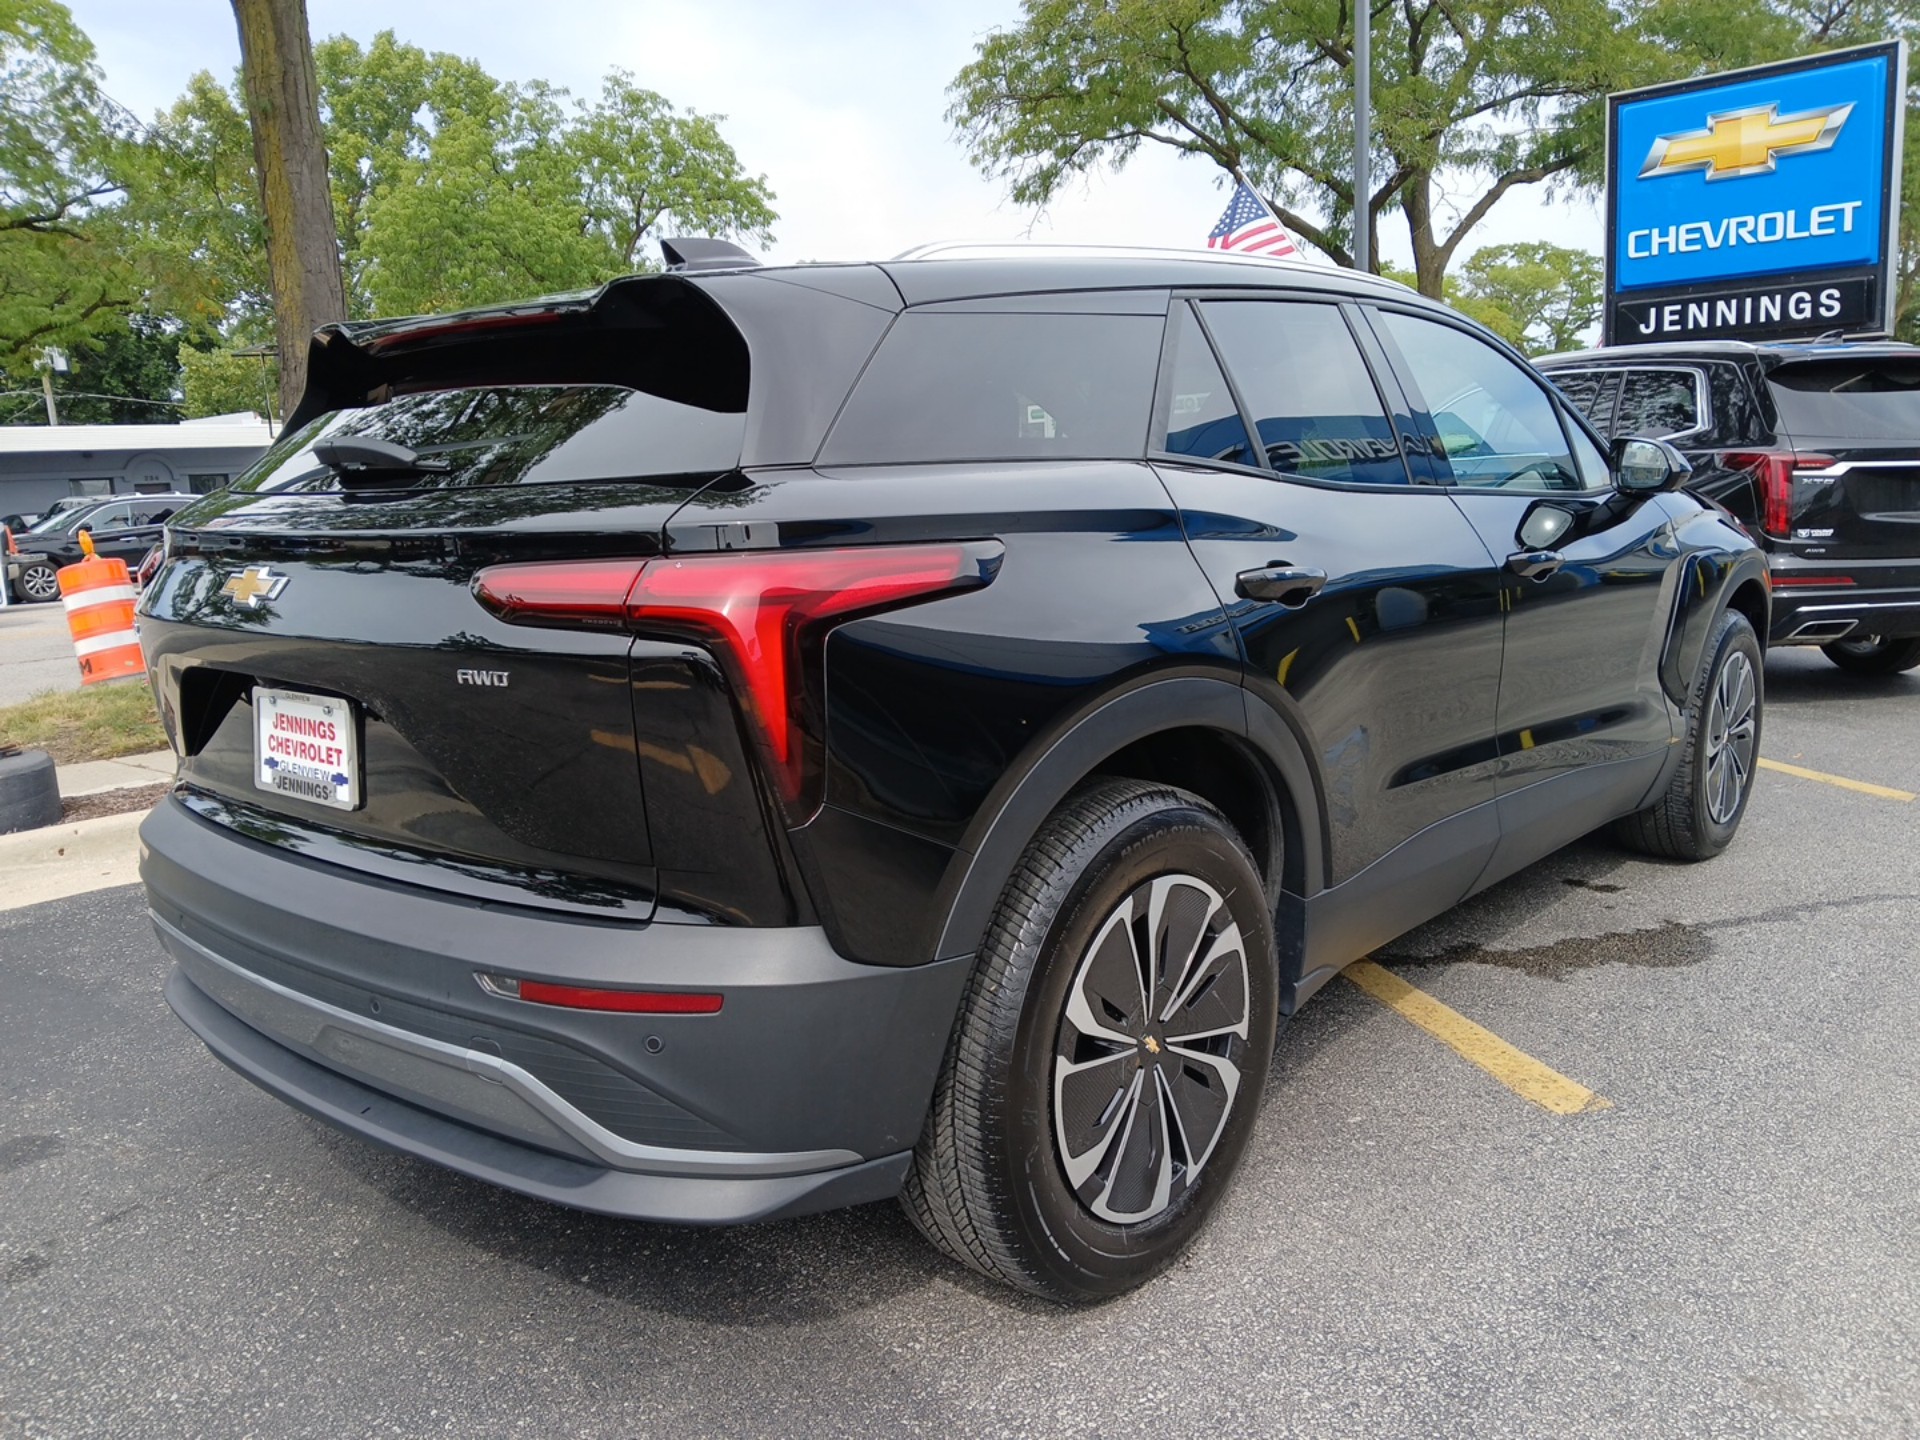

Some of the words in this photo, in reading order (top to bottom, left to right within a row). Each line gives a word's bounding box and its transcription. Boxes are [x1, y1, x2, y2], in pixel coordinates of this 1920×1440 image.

[1627, 200, 1862, 259] CHEVROLET
[1639, 288, 1842, 334] JENNINGS
[272, 712, 336, 741] JENNINGS
[267, 734, 343, 767] CHEVROLET
[279, 760, 331, 781] GLENVIEW
[276, 775, 329, 800] JENNINGS
